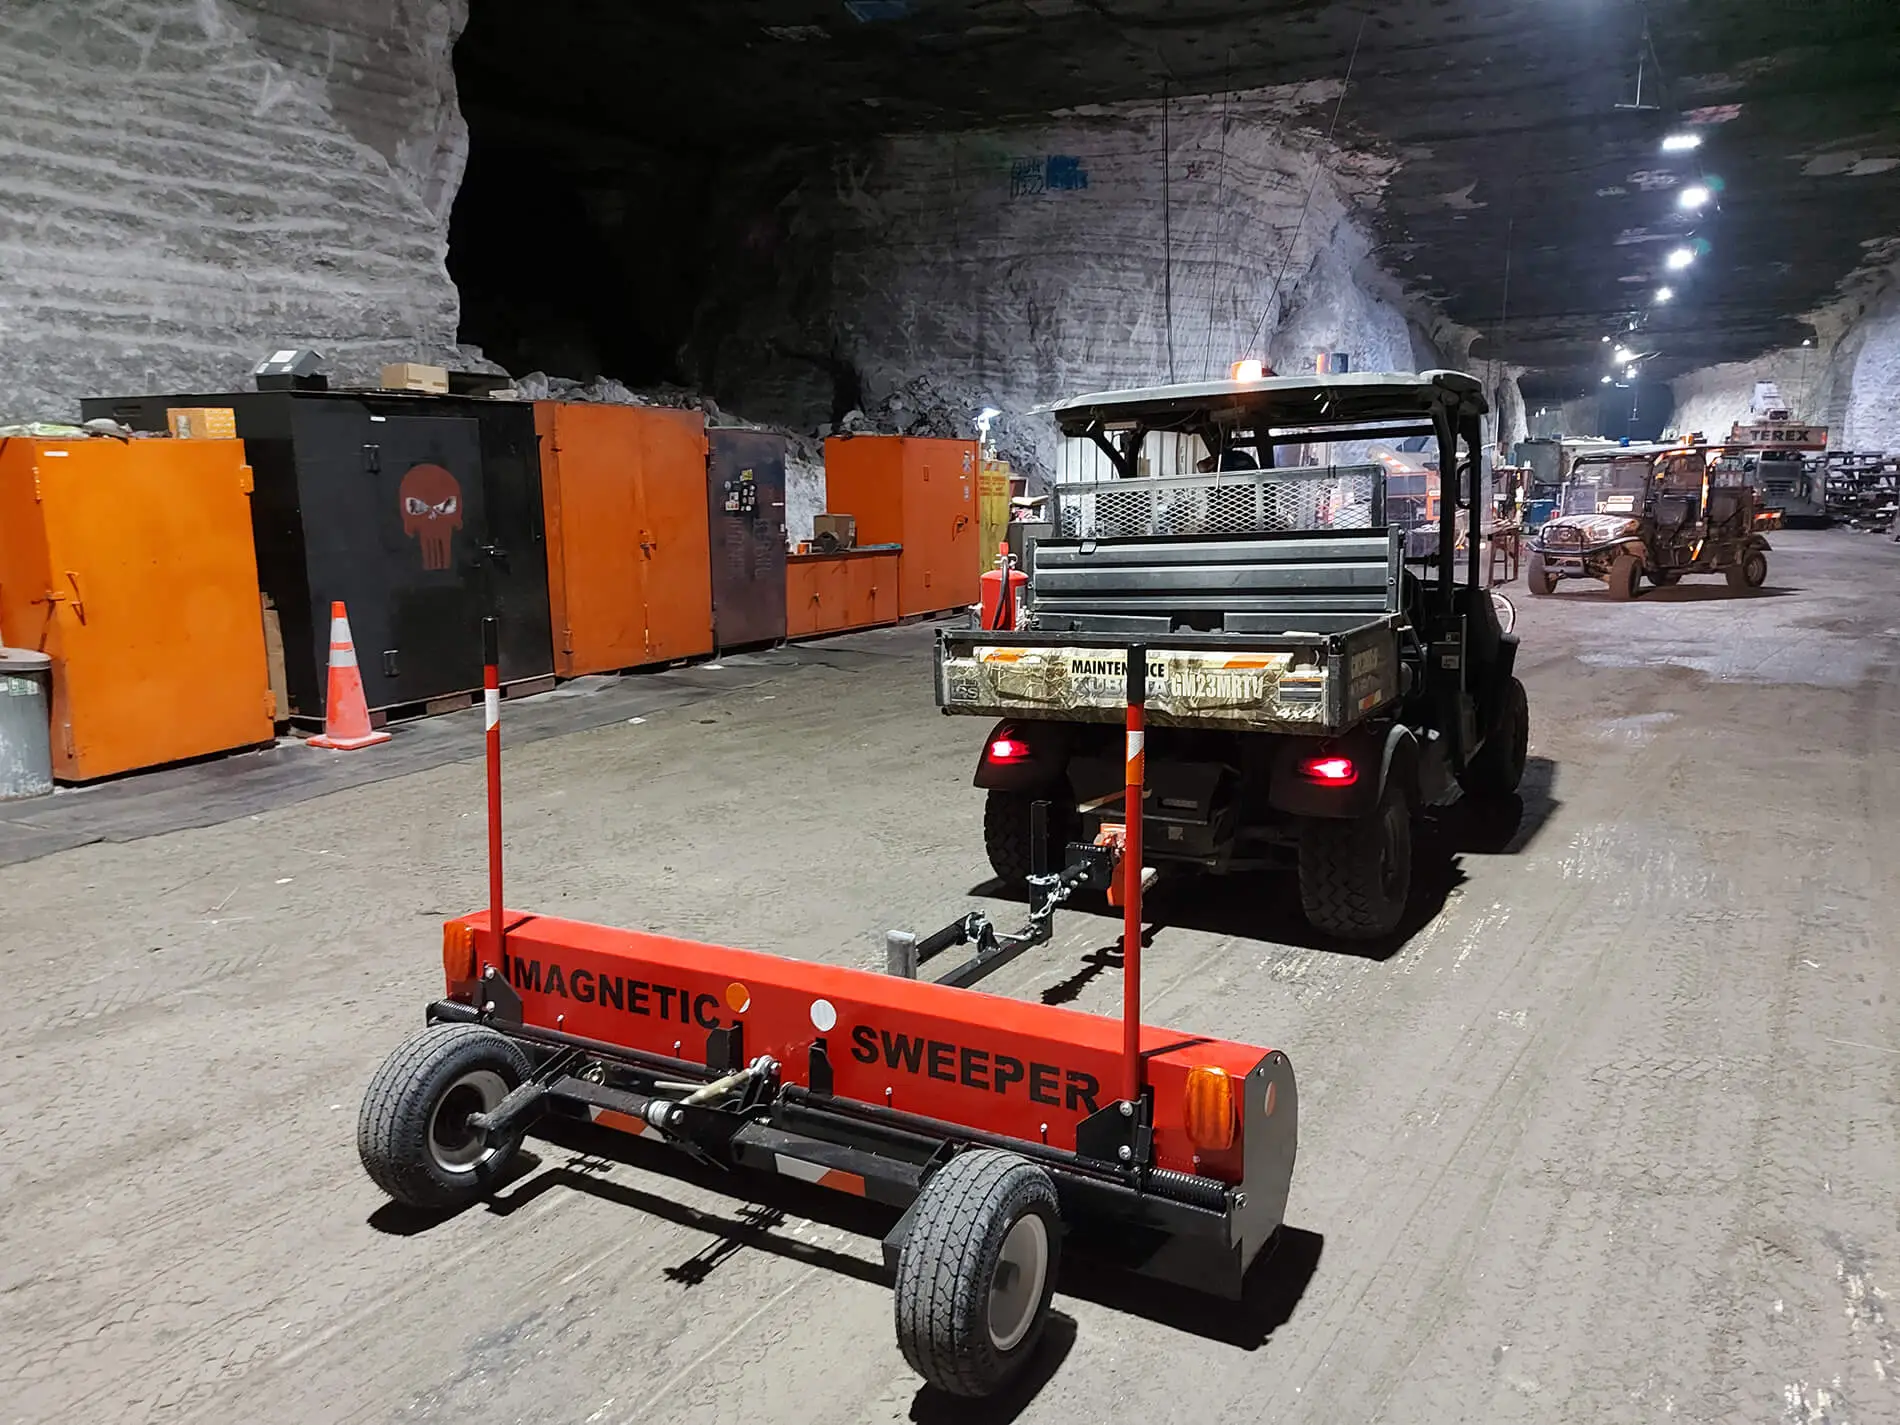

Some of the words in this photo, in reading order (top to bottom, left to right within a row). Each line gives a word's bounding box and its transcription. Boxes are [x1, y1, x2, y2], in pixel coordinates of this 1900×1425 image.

[1750, 430, 1810, 441] TEREX
[1072, 660, 1165, 678] MAINTENCE
[1171, 673, 1264, 698] GM23MRTV
[514, 956, 720, 1030] MAGNETIC
[851, 1025, 1100, 1115] SWEEPER
